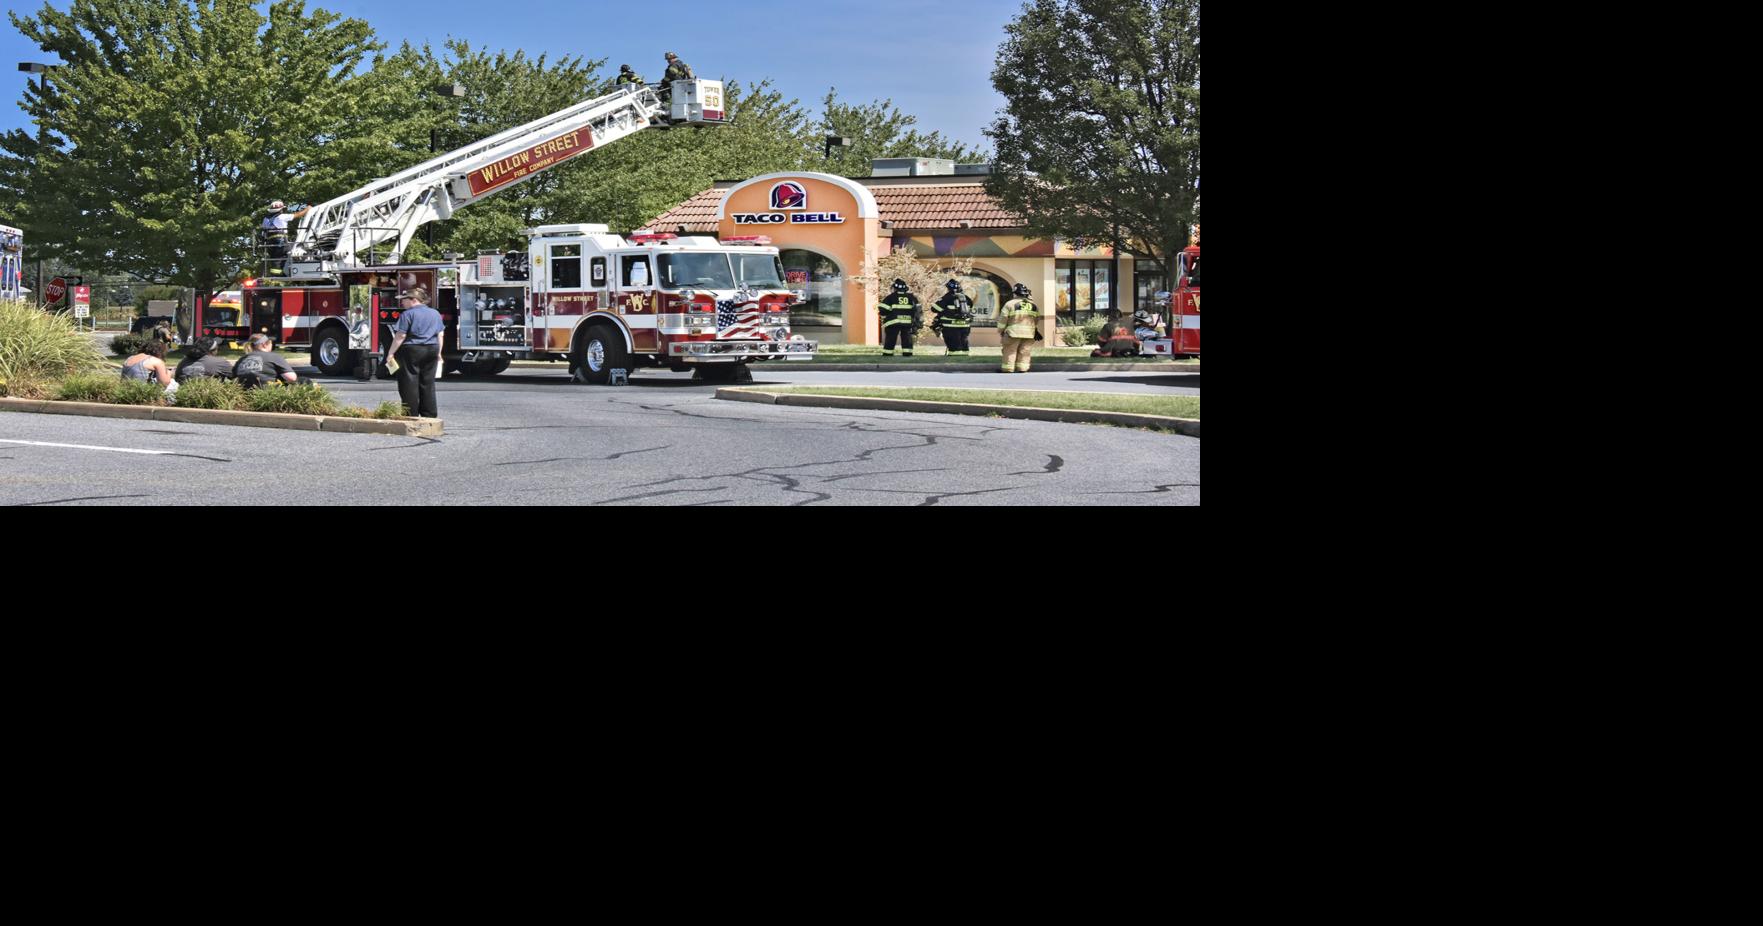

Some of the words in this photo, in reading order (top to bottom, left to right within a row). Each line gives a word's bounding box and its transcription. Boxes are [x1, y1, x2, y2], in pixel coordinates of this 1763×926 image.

[704, 86, 720, 94] TOWER
[705, 95, 719, 106] 50
[481, 151, 530, 184] WILLOW
[534, 132, 580, 159] STREET
[513, 168, 528, 179] FIRE
[529, 156, 555, 172] COMPANY
[732, 213, 786, 224] TACO
[791, 213, 844, 223] BELL
[786, 271, 806, 279] DRIVE
[47, 284, 65, 297] STOP
[898, 296, 909, 305] 50
[970, 307, 989, 315] ORE
[1020, 302, 1032, 311] 50
